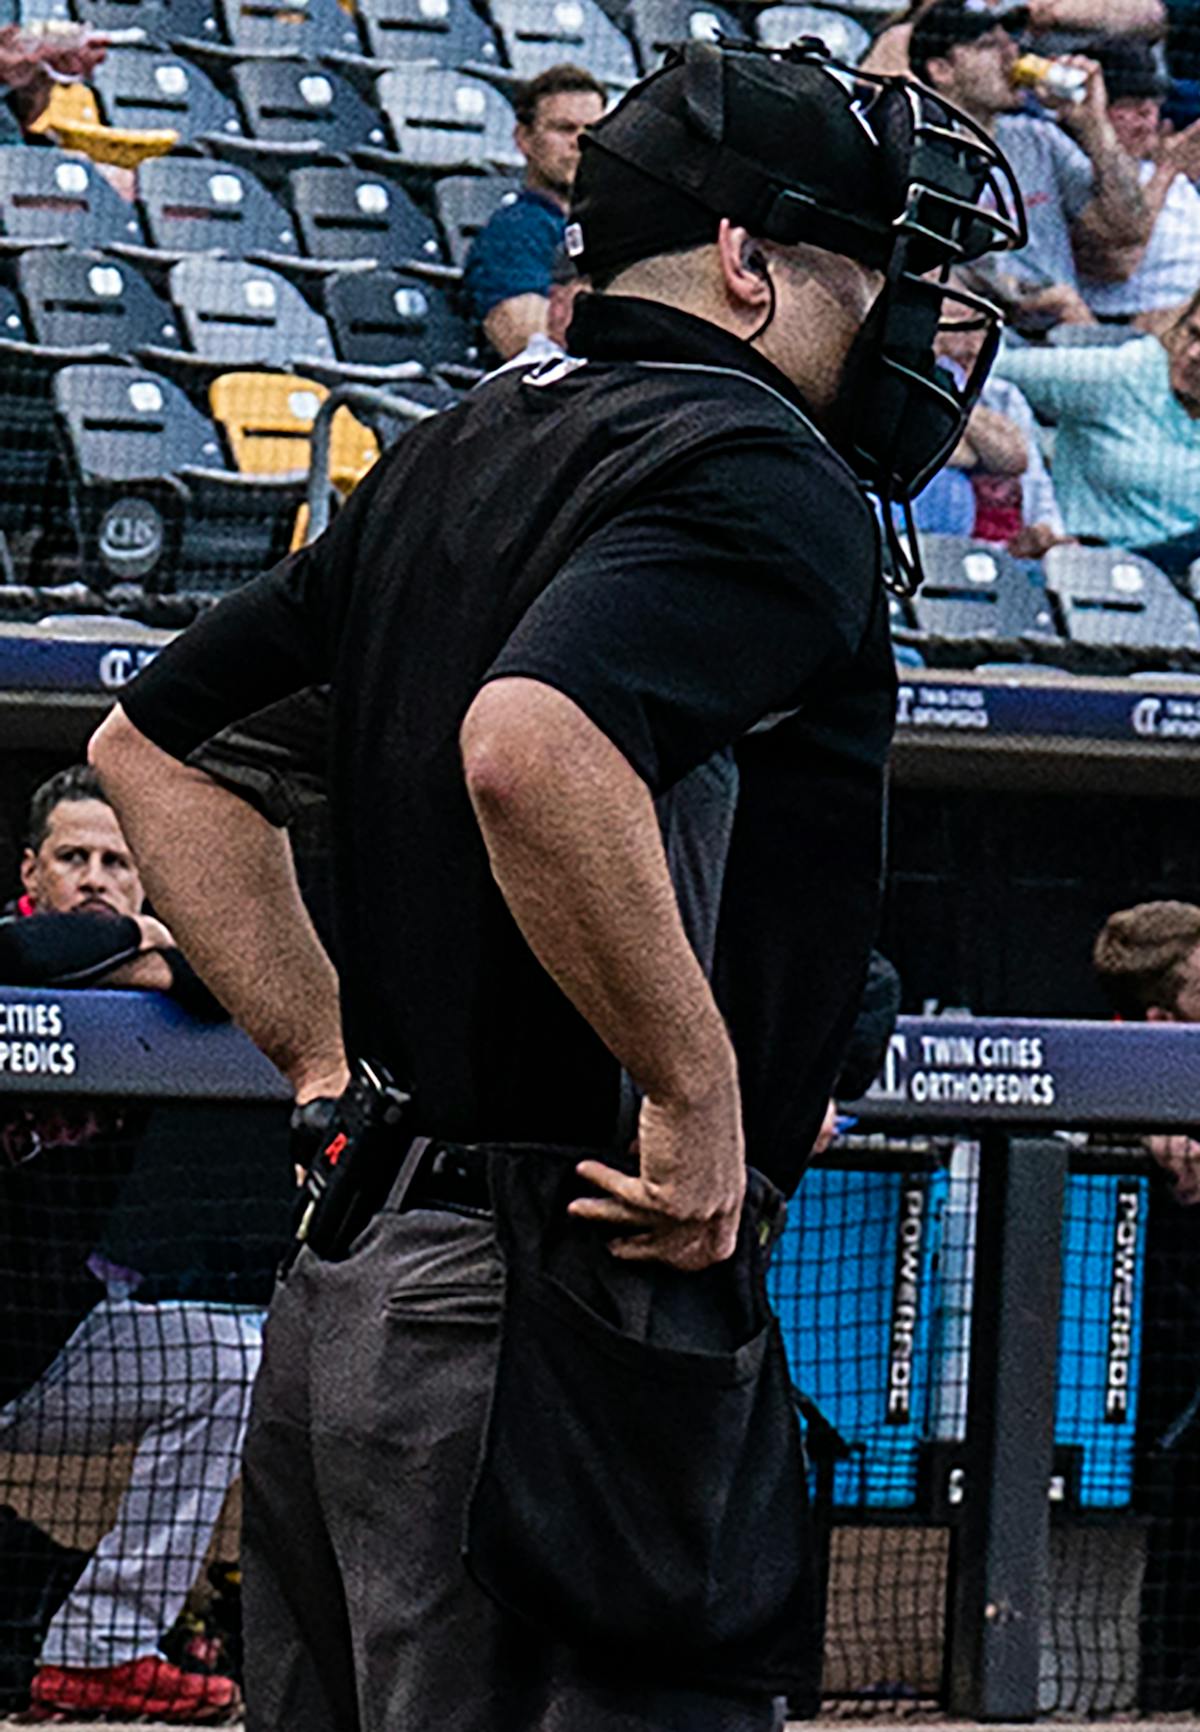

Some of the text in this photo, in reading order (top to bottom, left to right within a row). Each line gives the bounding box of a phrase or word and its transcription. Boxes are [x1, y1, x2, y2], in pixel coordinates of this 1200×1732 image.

[921, 1035, 1043, 1069] TWIN CITIES
[911, 1070, 1056, 1105] ORTHOPEDICS
